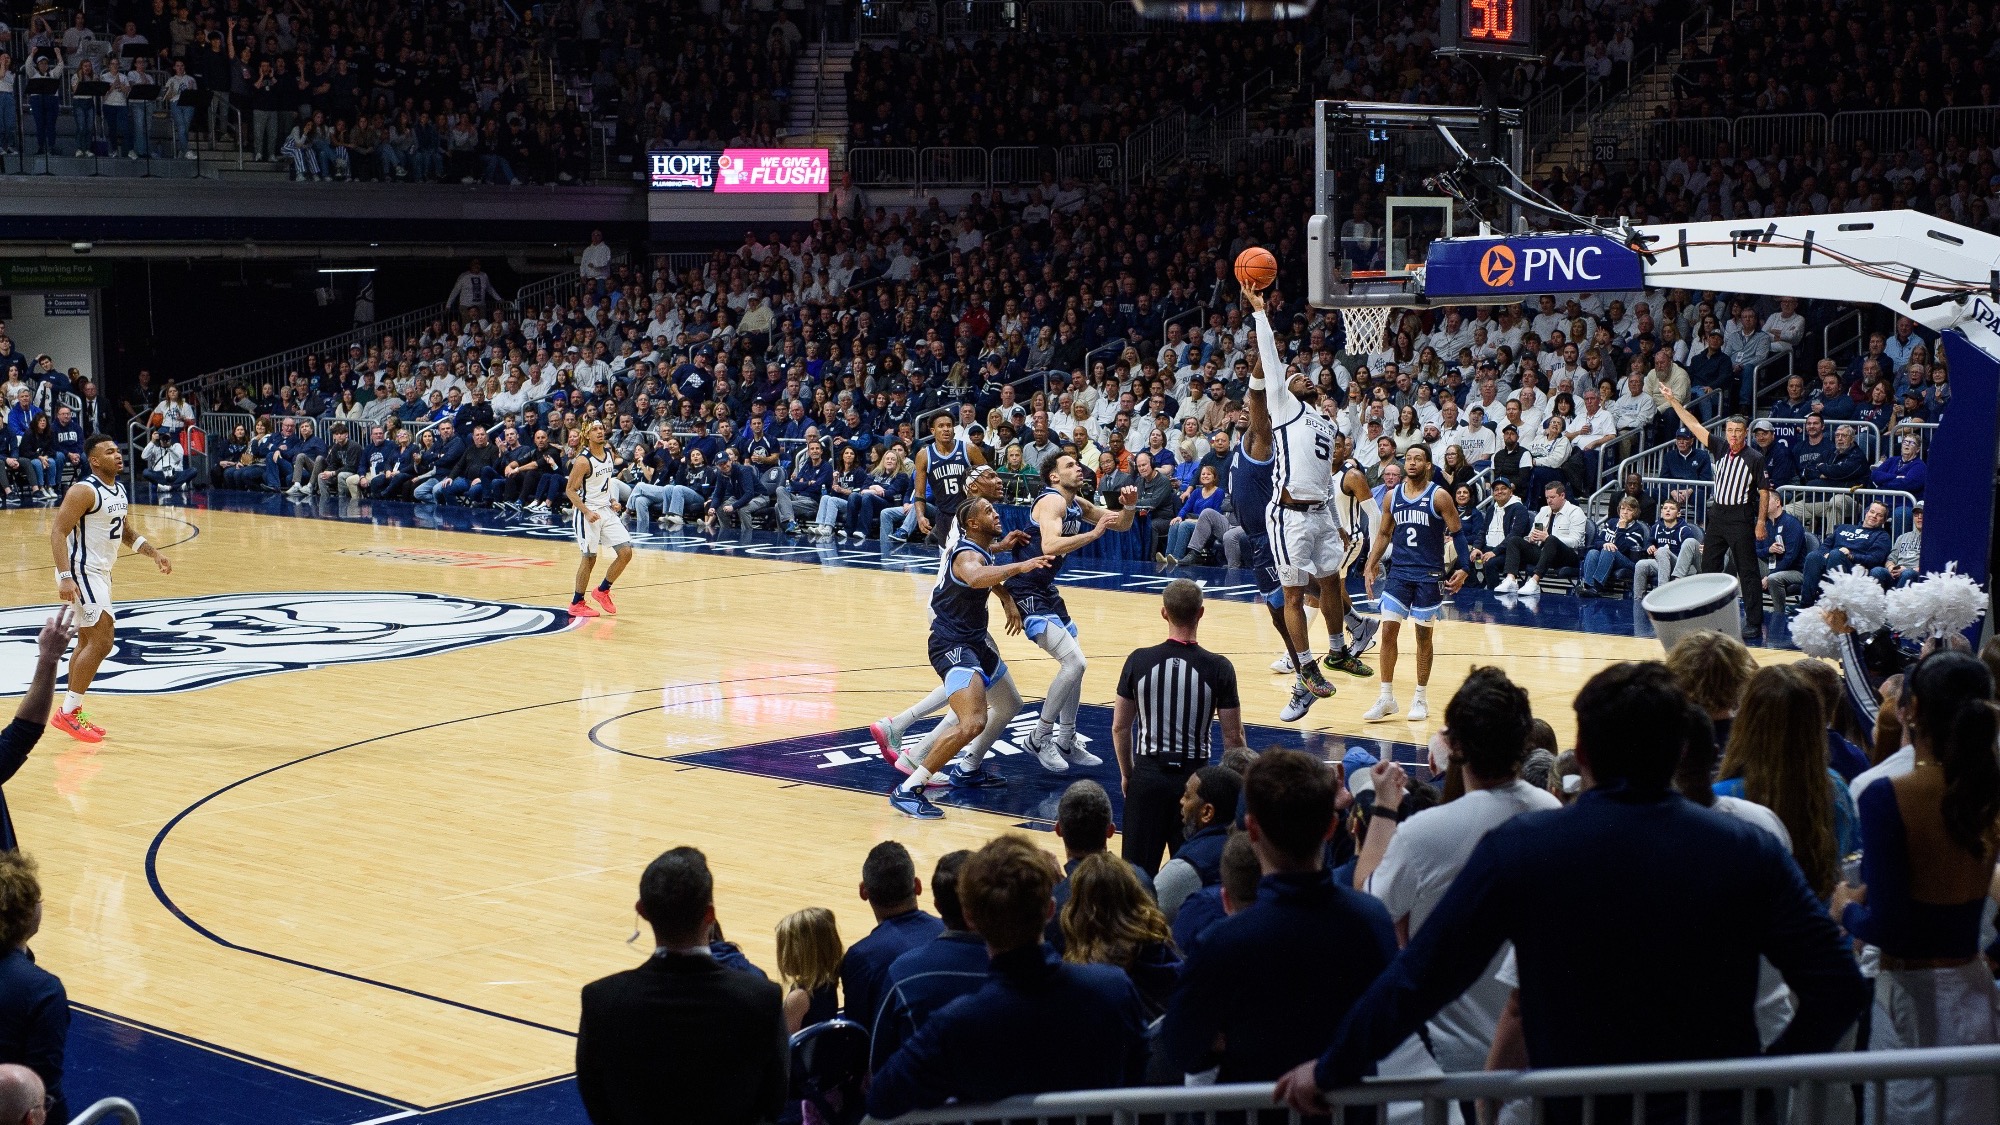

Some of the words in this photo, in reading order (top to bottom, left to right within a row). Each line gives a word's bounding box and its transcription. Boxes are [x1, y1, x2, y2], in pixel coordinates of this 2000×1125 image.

[1595, 145, 1614, 160] 218
[652, 155, 712, 175] HOPE
[761, 157, 781, 167] WE
[782, 157, 811, 167] GIVE
[812, 157, 821, 167] A
[750, 167, 828, 185] FLUSH!
[1522, 246, 1602, 282] PNC
[1315, 433, 1330, 461] 5
[600, 477, 609, 493] 4
[943, 478, 959, 495] 15
[1393, 509, 1430, 526] VILLANOVA
[1406, 527, 1418, 547] 2
